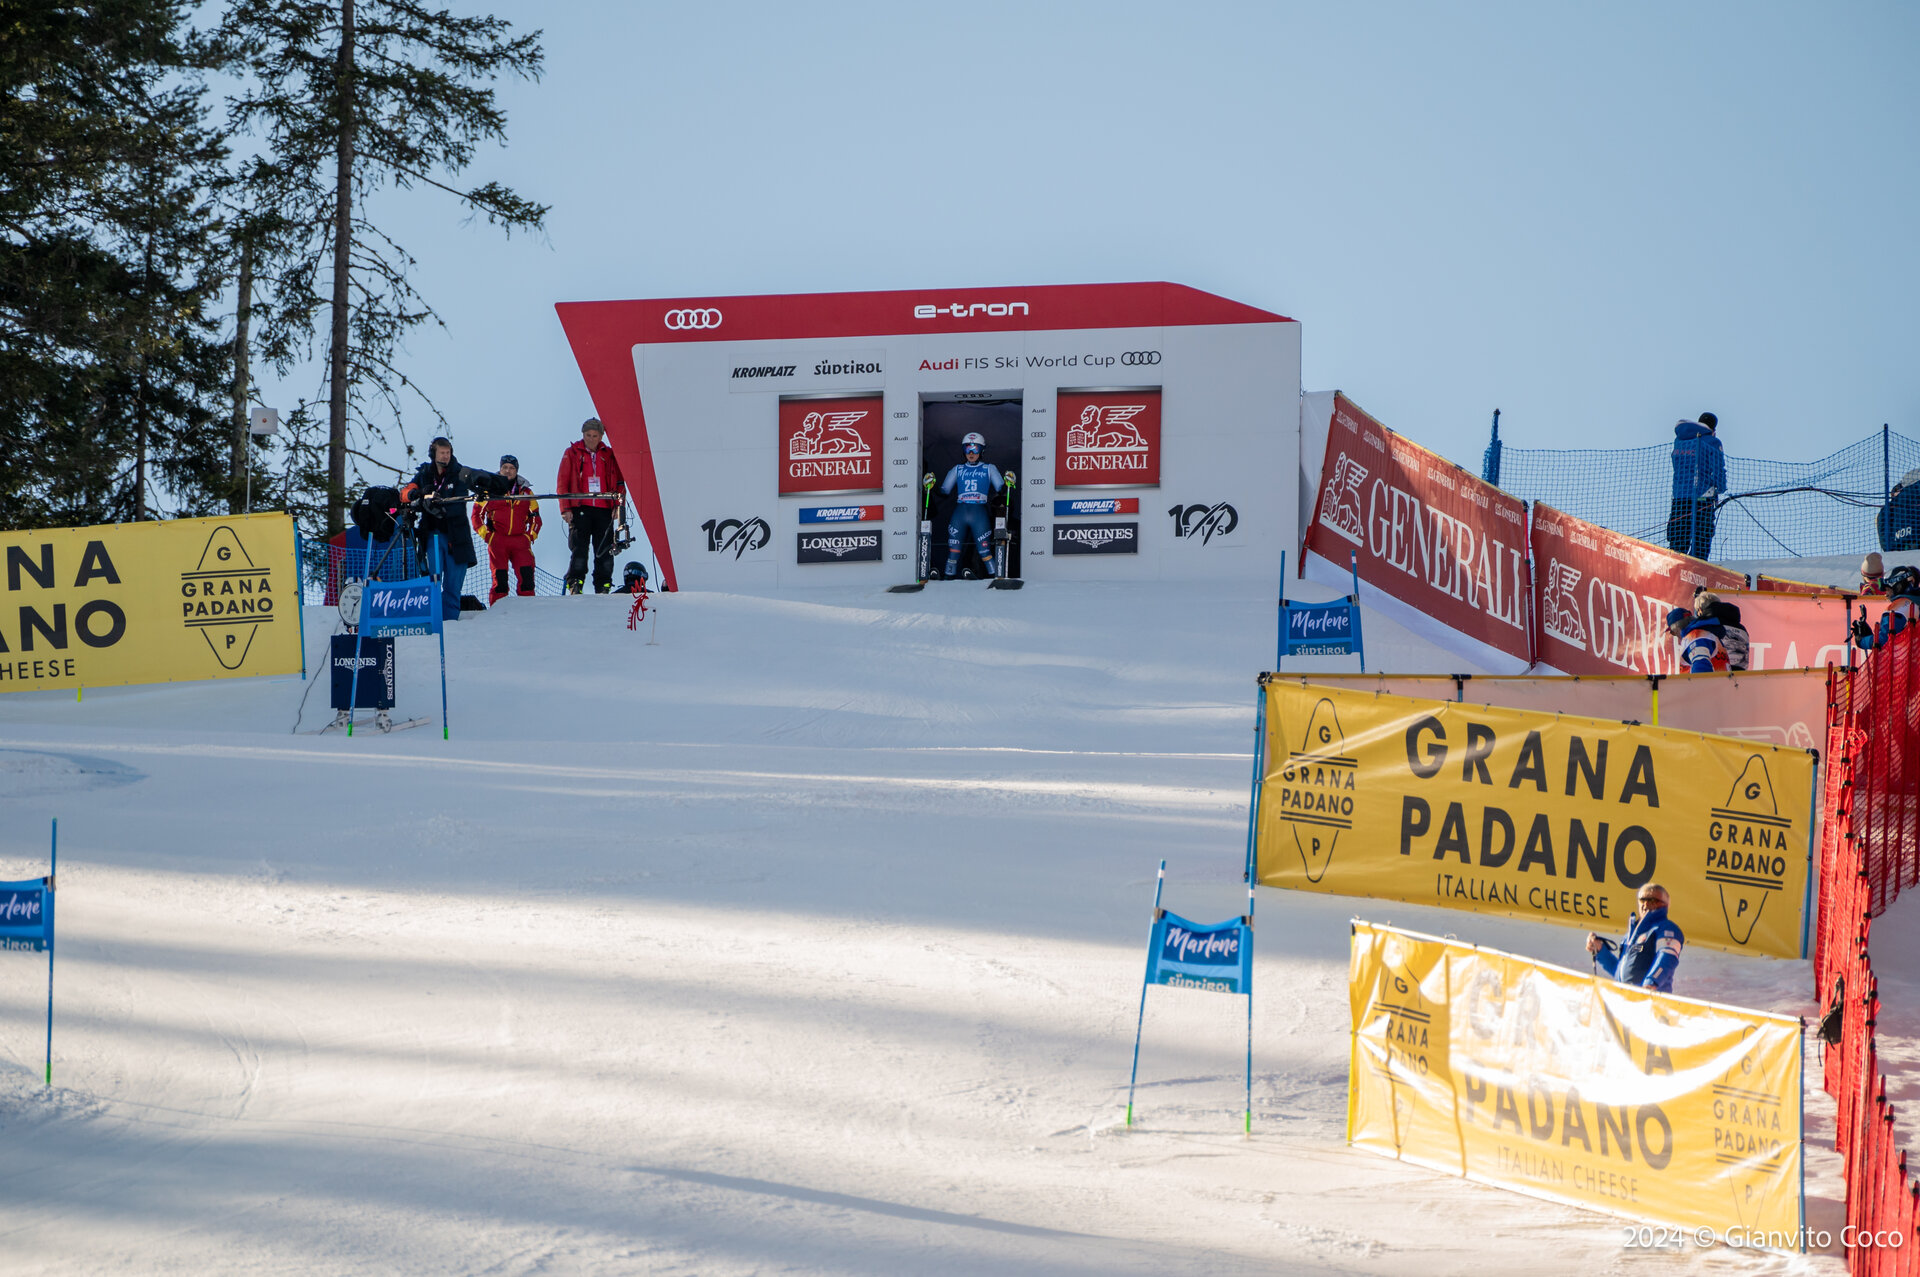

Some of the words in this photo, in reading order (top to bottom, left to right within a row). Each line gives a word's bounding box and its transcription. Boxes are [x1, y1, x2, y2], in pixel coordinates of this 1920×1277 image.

[914, 302, 1029, 318] e-tron
[732, 366, 797, 378] KRONPLATZ
[919, 359, 959, 371] Audi
[964, 357, 989, 370] FIS
[995, 356, 1019, 369] Ski
[1026, 355, 1078, 368] World
[1083, 354, 1115, 368] Cup
[789, 459, 872, 478] GENERALI
[1066, 454, 1149, 471] GENERALI
[964, 479, 978, 492] 25
[816, 507, 860, 517] KRONPLATZ
[1071, 500, 1115, 510] KRONPLATZ
[801, 535, 878, 549] LONGINES
[1057, 528, 1134, 541] LONGINES
[1894, 526, 1912, 541] NOR
[217, 546, 231, 561] G
[1369, 478, 1524, 631] GENERALI
[181, 578, 272, 598] GRANA
[182, 597, 274, 617] PADANO
[372, 590, 429, 617] Marlene
[1291, 610, 1349, 638] Marlene
[226, 634, 236, 649] P
[334, 657, 377, 667] LONGNES
[385, 643, 393, 700] LONGINES
[1319, 725, 1331, 744] G
[1405, 714, 1660, 809] GRANA
[1283, 764, 1356, 790] GRANA
[1745, 782, 1761, 800] G
[1281, 788, 1354, 816] PADANO
[1400, 795, 1657, 890] PADANO
[1709, 821, 1788, 851] GRANA
[1312, 837, 1321, 857] P
[1706, 847, 1786, 877] PADANO
[1437, 873, 1520, 906] ITALIAN
[1529, 887, 1610, 919] CHEESE
[1737, 898, 1749, 918] P
[1166, 927, 1239, 962] Marlene
[1394, 976, 1409, 995] G
[1741, 1055, 1752, 1076] G
[1464, 1060, 1674, 1171] PADANO
[1713, 1100, 1782, 1132] GRANA
[1714, 1127, 1782, 1160] PADANO
[1497, 1145, 1564, 1185] ITALIAN
[1572, 1165, 1639, 1204] CHEESE
